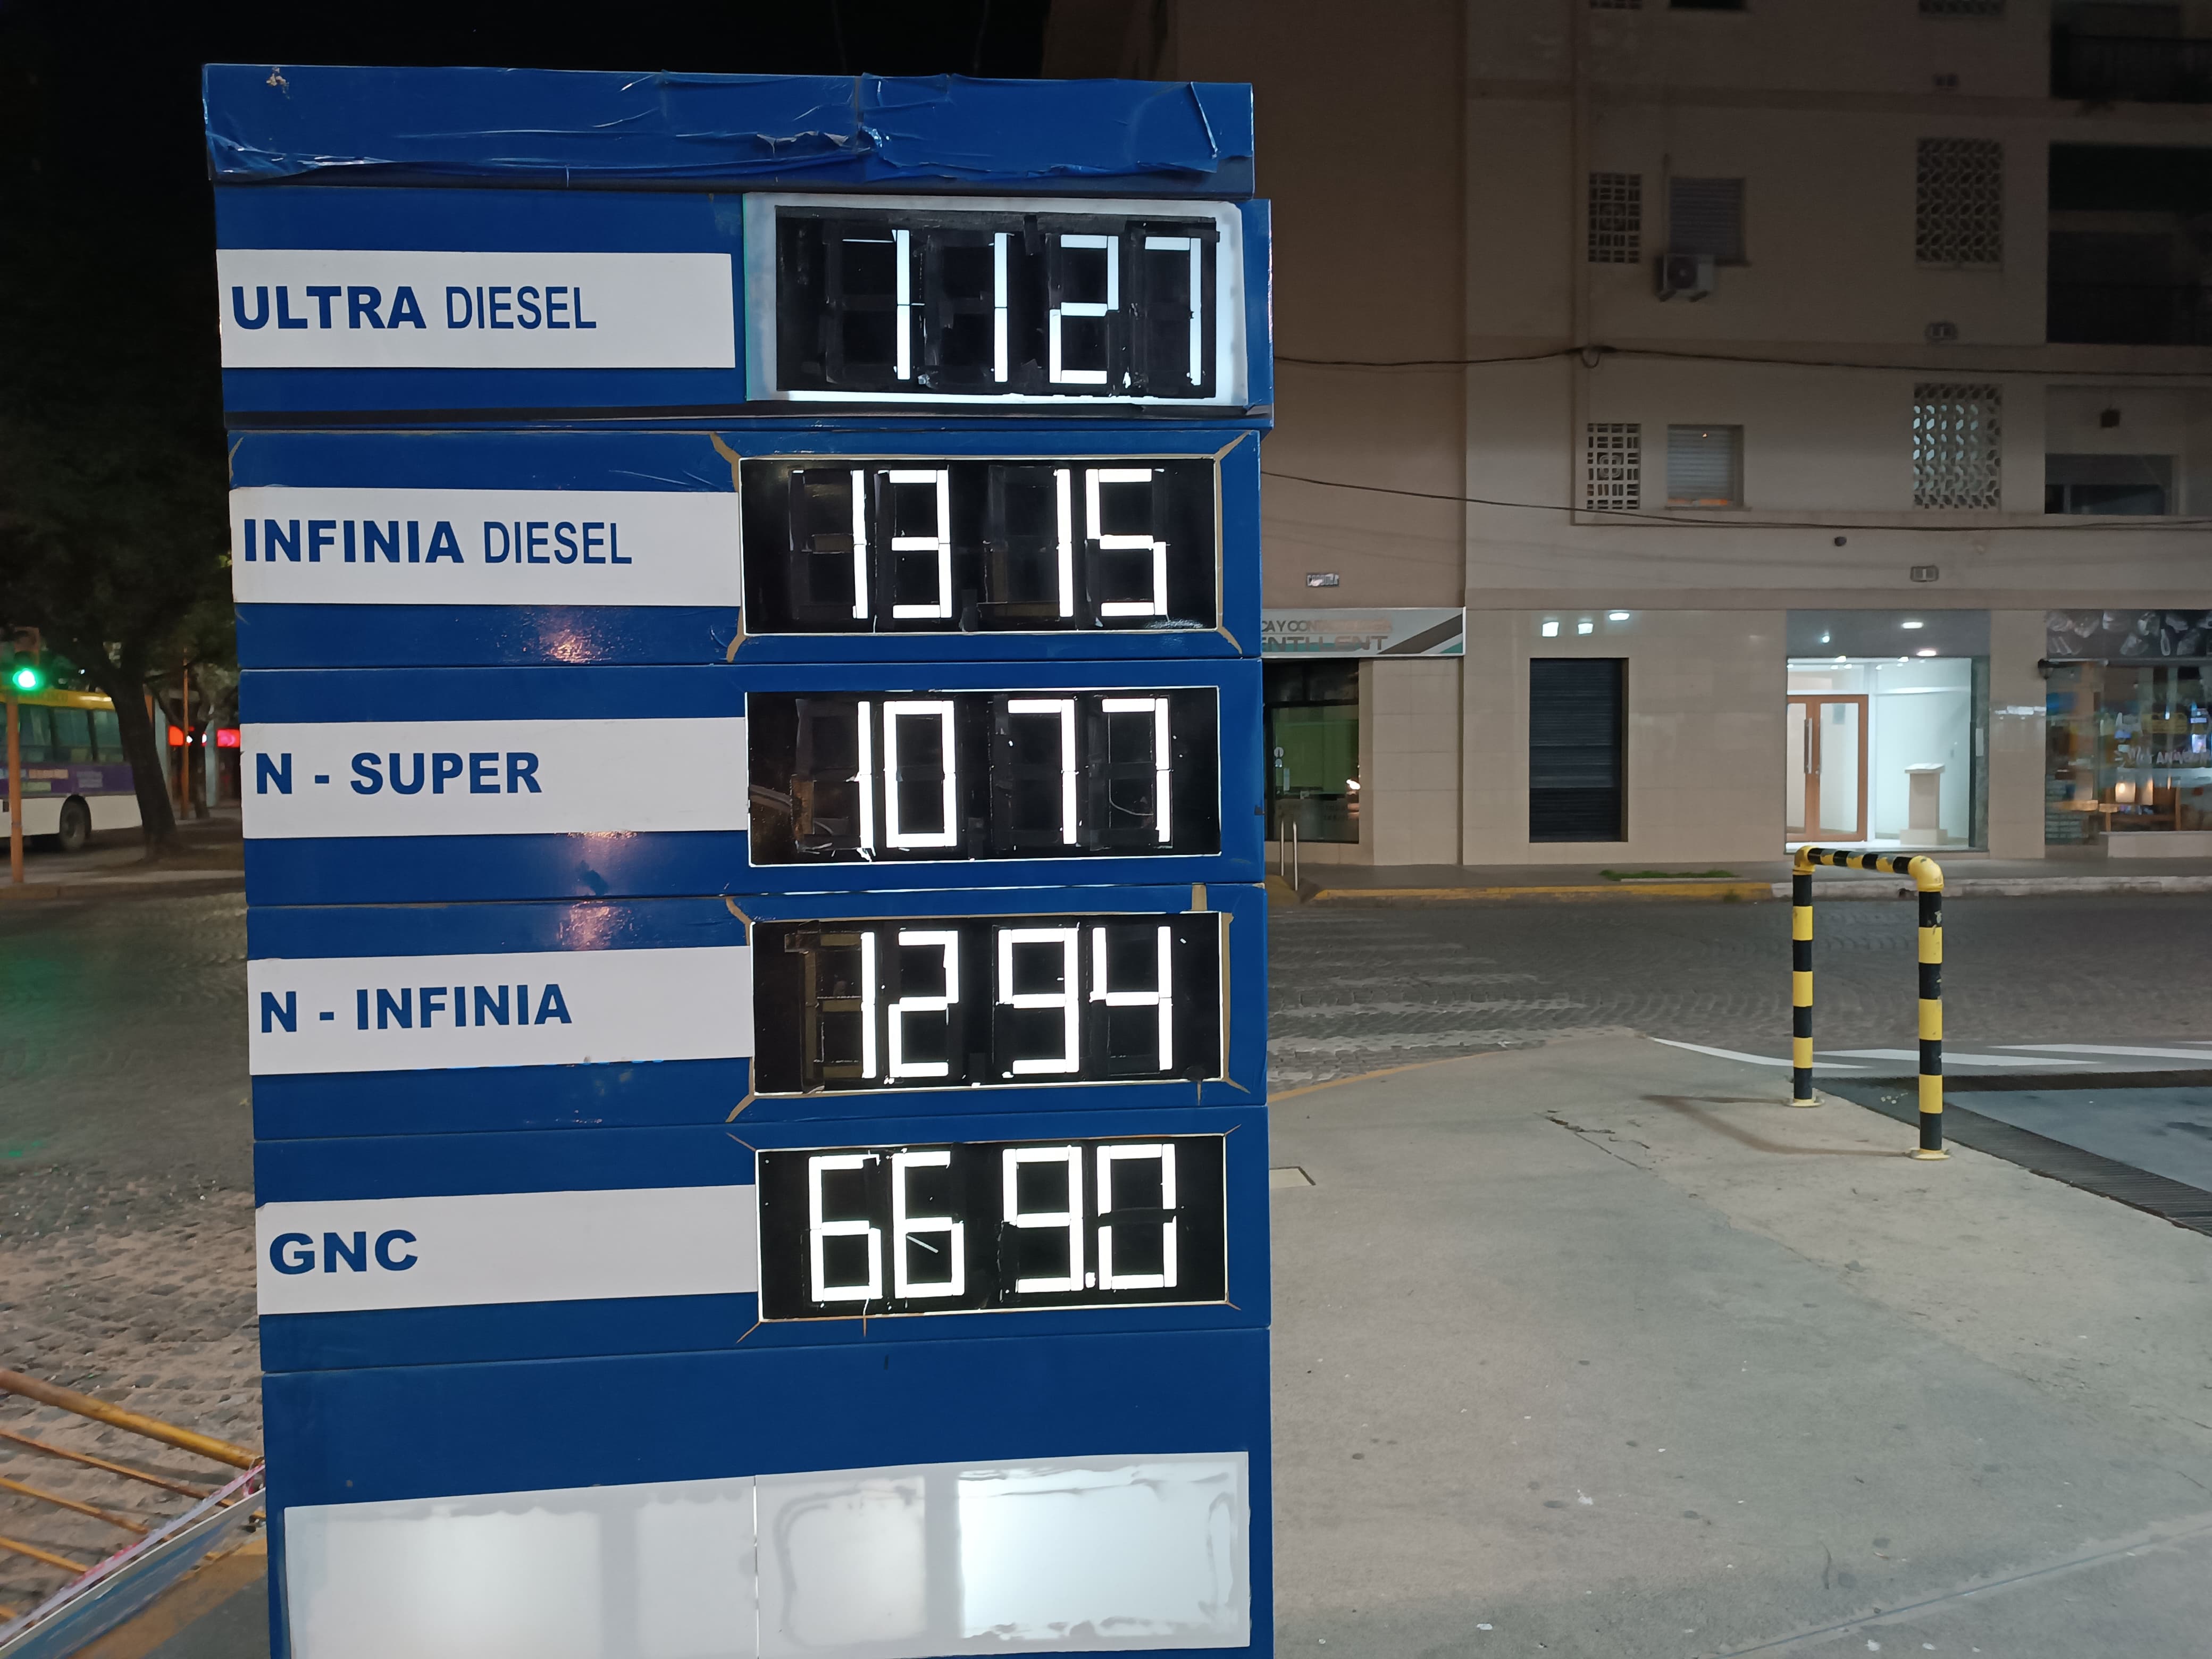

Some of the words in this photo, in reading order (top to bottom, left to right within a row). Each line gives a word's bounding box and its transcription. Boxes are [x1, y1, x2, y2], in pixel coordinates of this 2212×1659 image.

[232, 286, 426, 329] ULTRA
[446, 286, 596, 329] DIESEL
[896, 229, 1201, 386] 1127
[245, 519, 464, 563] INFINIA
[484, 522, 632, 564] DIESEL
[852, 468, 1168, 619] 1315
[256, 753, 292, 794] N
[350, 752, 541, 794] SUPER
[857, 698, 1171, 848] 1077
[261, 991, 296, 1033] N
[357, 984, 572, 1029] INFINIA
[861, 926, 1173, 1078] 1294
[270, 1230, 417, 1275] GNC
